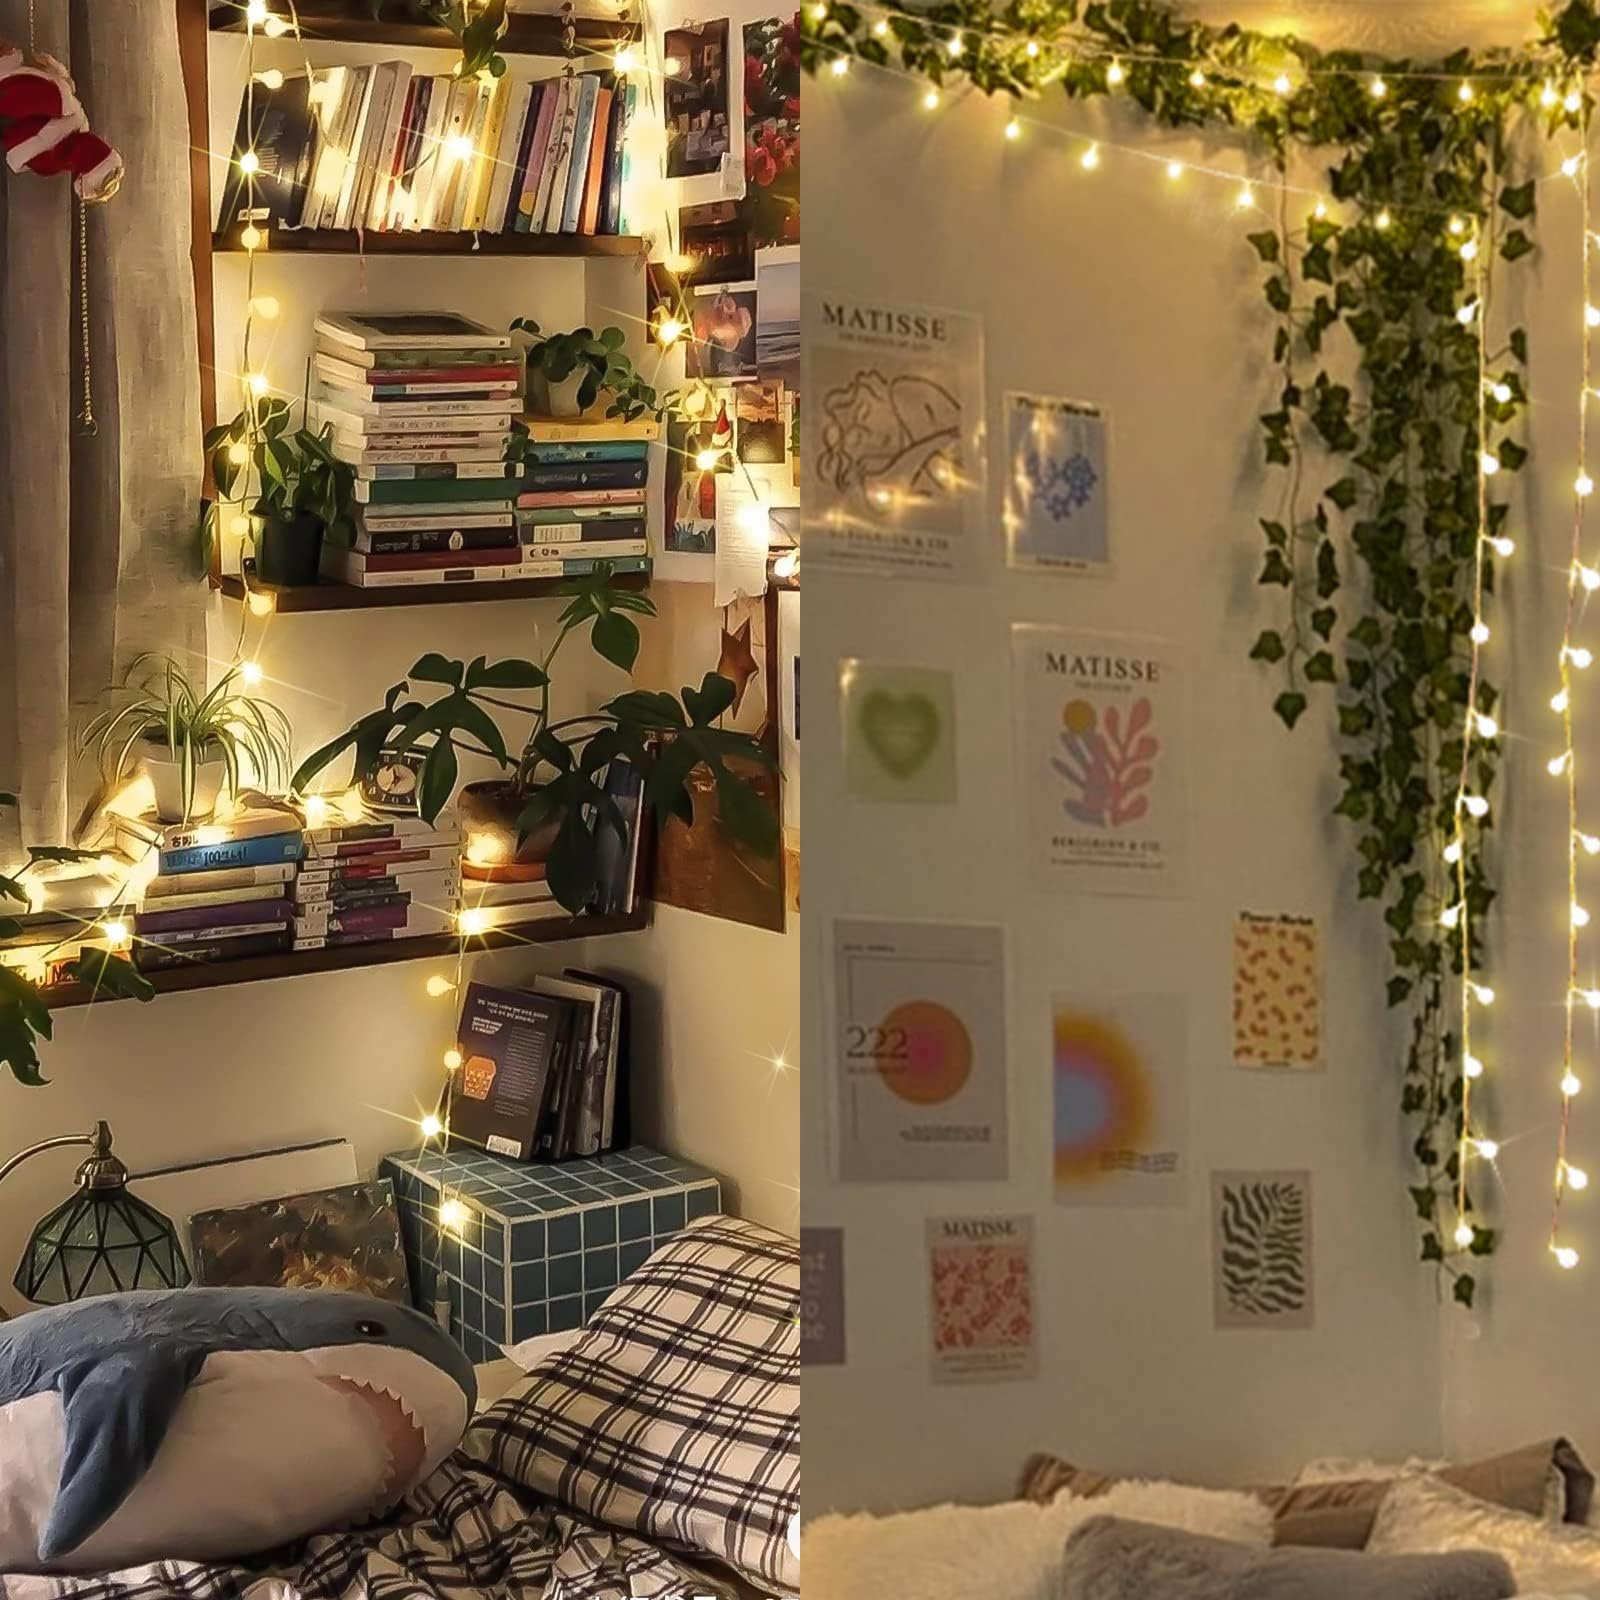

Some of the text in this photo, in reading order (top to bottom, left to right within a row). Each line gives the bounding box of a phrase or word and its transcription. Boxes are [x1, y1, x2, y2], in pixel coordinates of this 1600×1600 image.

[822, 302, 946, 341] MATISSE
[1045, 651, 1160, 683] MATISSE
[846, 1024, 908, 1052] 222
[943, 1220, 1016, 1238] MATISSE
